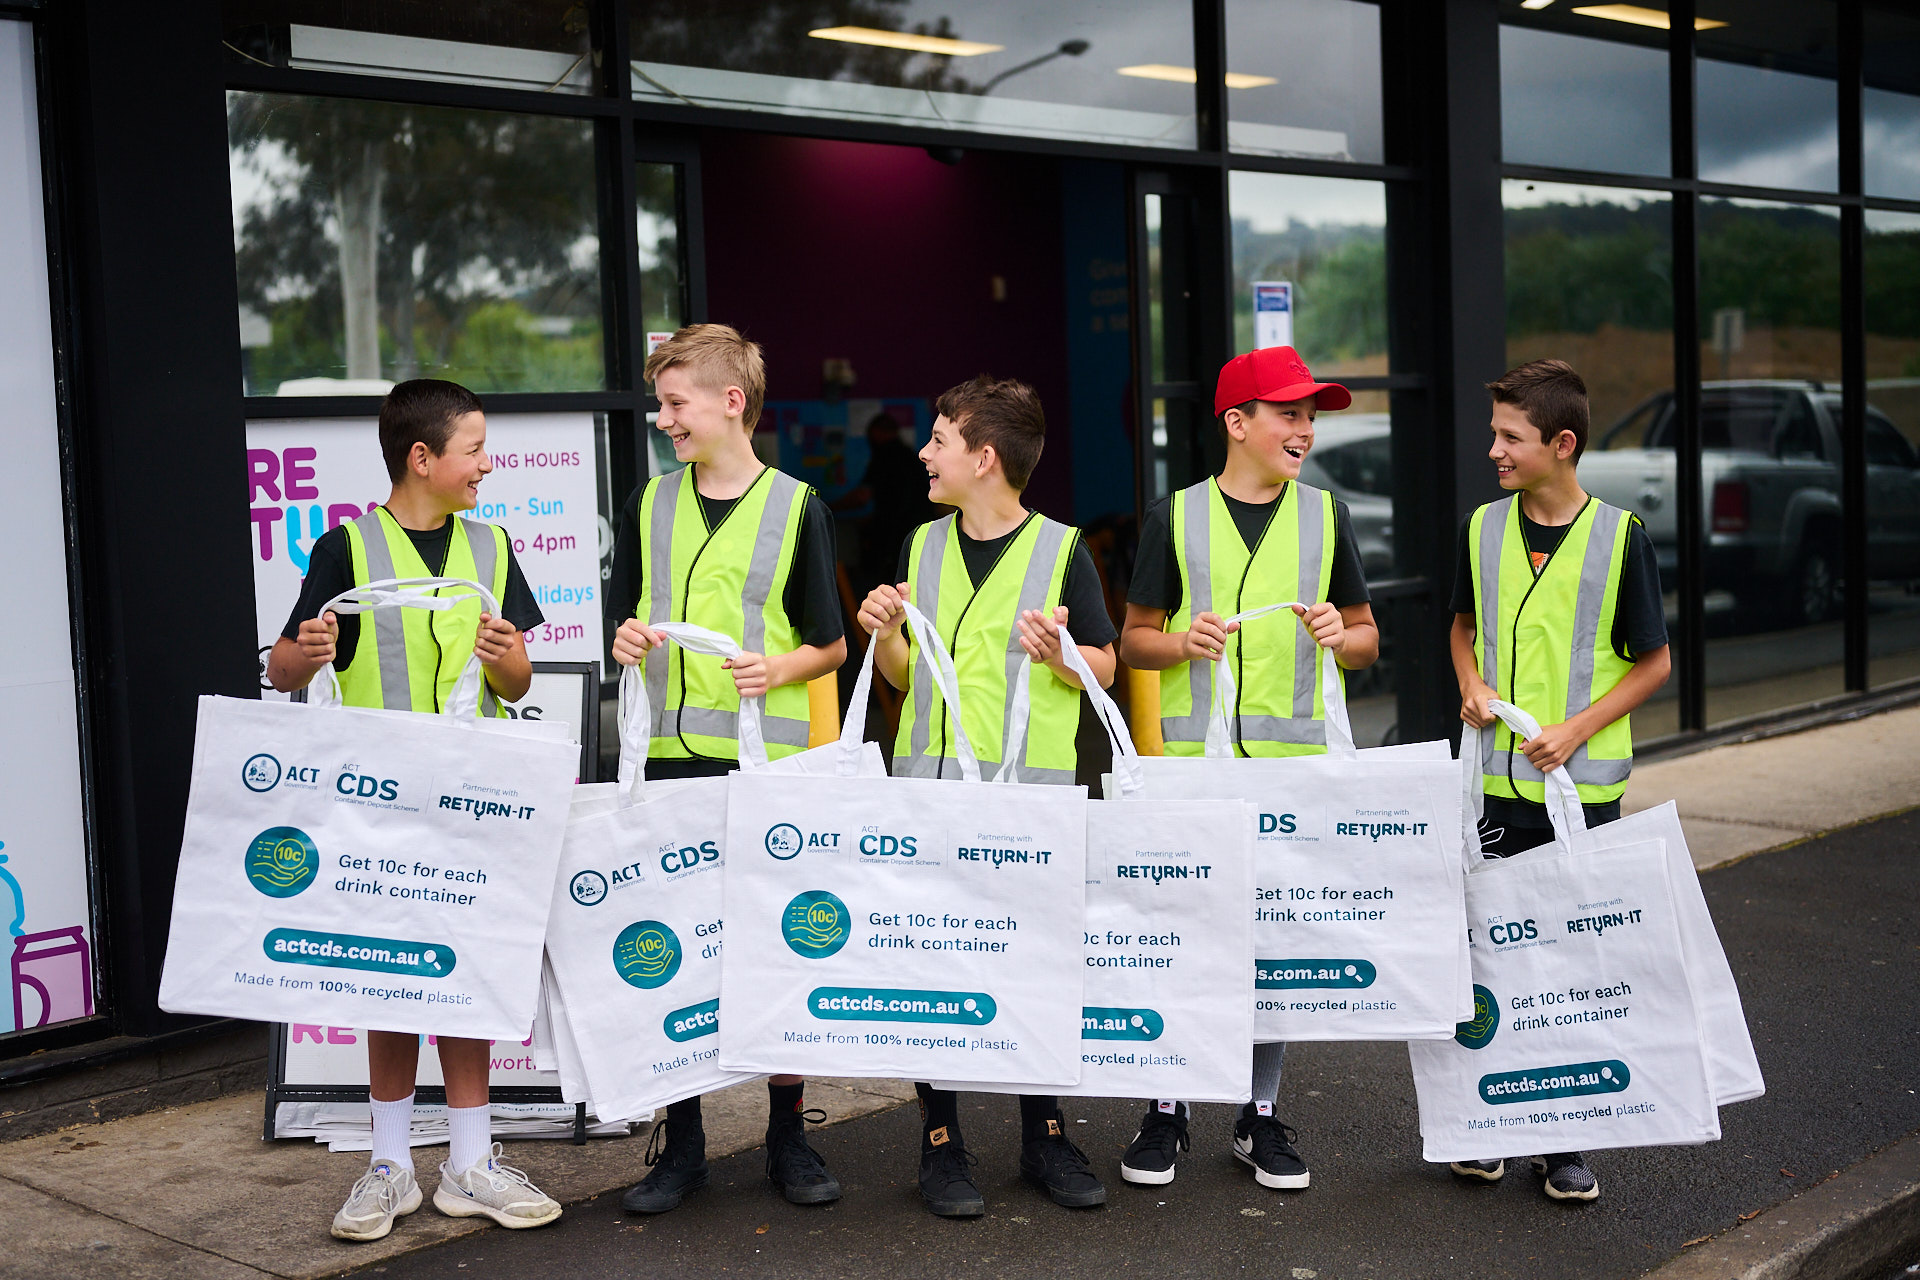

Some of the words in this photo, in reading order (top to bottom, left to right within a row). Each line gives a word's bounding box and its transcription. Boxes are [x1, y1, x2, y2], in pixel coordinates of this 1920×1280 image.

[490, 453, 519, 468] ING
[525, 452, 579, 467] HOURS
[246, 446, 319, 503] RE
[464, 500, 507, 520] Mon
[527, 496, 564, 517] Sun
[533, 534, 575, 555] 4pm
[532, 584, 595, 606] lidays
[543, 624, 583, 644] 3pm
[286, 766, 320, 783] ACT
[341, 763, 360, 772] ACT
[336, 772, 400, 801] CDS
[462, 782, 498, 798] Partnering
[500, 787, 519, 798] with
[334, 795, 365, 807] Container
[367, 799, 392, 811] Deposit
[393, 803, 420, 813] Scheme
[439, 796, 535, 820] RETURN-IT
[1355, 809, 1391, 817] Partnering
[1393, 808, 1409, 816] with
[861, 825, 880, 833] ACT
[1260, 814, 1296, 833] DS
[1337, 823, 1428, 842] RETURN-IT
[808, 833, 840, 846] ACT
[860, 835, 917, 857] CDS
[977, 832, 1014, 843] Partnering
[1016, 834, 1033, 843] with
[277, 846, 302, 862] 10c
[658, 841, 675, 853] ACT
[1135, 850, 1170, 859] Partnering
[1171, 849, 1191, 858] with
[660, 840, 720, 874] CDS
[859, 857, 889, 865] Container
[890, 858, 914, 867] Deposit
[958, 848, 1051, 869] RETURN-IT
[339, 855, 371, 870] Get
[378, 860, 406, 874] 10c
[414, 862, 438, 877] for
[445, 870, 486, 884] each
[612, 863, 640, 884] ACT
[666, 868, 696, 883] Container
[696, 861, 720, 874] Deposit
[1118, 865, 1211, 885] RETURN-IT
[335, 877, 382, 895] drink
[390, 887, 476, 905] container
[1255, 886, 1283, 901] Get
[1288, 888, 1315, 900] 10c
[1322, 887, 1347, 899] for
[1353, 887, 1393, 900] each
[1577, 900, 1607, 910] Partnering
[811, 909, 834, 924] 10c
[870, 913, 900, 926] Get
[907, 914, 935, 927] 10c
[943, 914, 968, 928] for
[975, 917, 1016, 930] each
[1255, 907, 1297, 922] drink
[1303, 908, 1385, 921] container
[1487, 915, 1503, 925] ACT
[1567, 910, 1641, 936] RETURN-IT
[696, 919, 723, 936] Get
[1489, 918, 1538, 946] CDS
[639, 938, 662, 953] 10c
[869, 934, 914, 948] drink
[922, 938, 1008, 952] container
[1106, 931, 1131, 944] for
[1139, 932, 1180, 945] each
[274, 939, 419, 967] actcds.com.au
[701, 940, 723, 960] dri
[1087, 954, 1173, 967] container
[235, 972, 274, 986] Made
[280, 976, 312, 989] from
[320, 981, 356, 993] 100%
[362, 988, 422, 1000] recycled
[428, 991, 471, 1004] plastic
[1512, 996, 1534, 1009] Get
[1539, 993, 1564, 1005] 10c
[1569, 988, 1589, 1001] for
[1595, 982, 1631, 998] each
[818, 995, 959, 1014] actcds.com.au
[1256, 1001, 1285, 1010] 00%
[1291, 1000, 1346, 1012] recycled
[1353, 1000, 1396, 1012] plastic
[1513, 1015, 1550, 1031] drink
[1555, 1007, 1628, 1025] container
[785, 1032, 820, 1042] Made
[827, 1032, 858, 1043] from
[865, 1035, 901, 1045] 100%
[907, 1037, 965, 1049] recycled
[972, 1038, 1017, 1051] plastic
[489, 1055, 537, 1070] wort
[653, 1057, 688, 1074] Made
[1082, 1053, 1134, 1065] ecycled
[1141, 1054, 1186, 1067] plastic
[1487, 1073, 1599, 1095] actcds.com.au
[1468, 1118, 1495, 1129] Made
[1500, 1116, 1524, 1126] from
[1528, 1112, 1558, 1123] 100%
[1563, 1106, 1612, 1121] recycled
[1617, 1102, 1655, 1118] plastic
